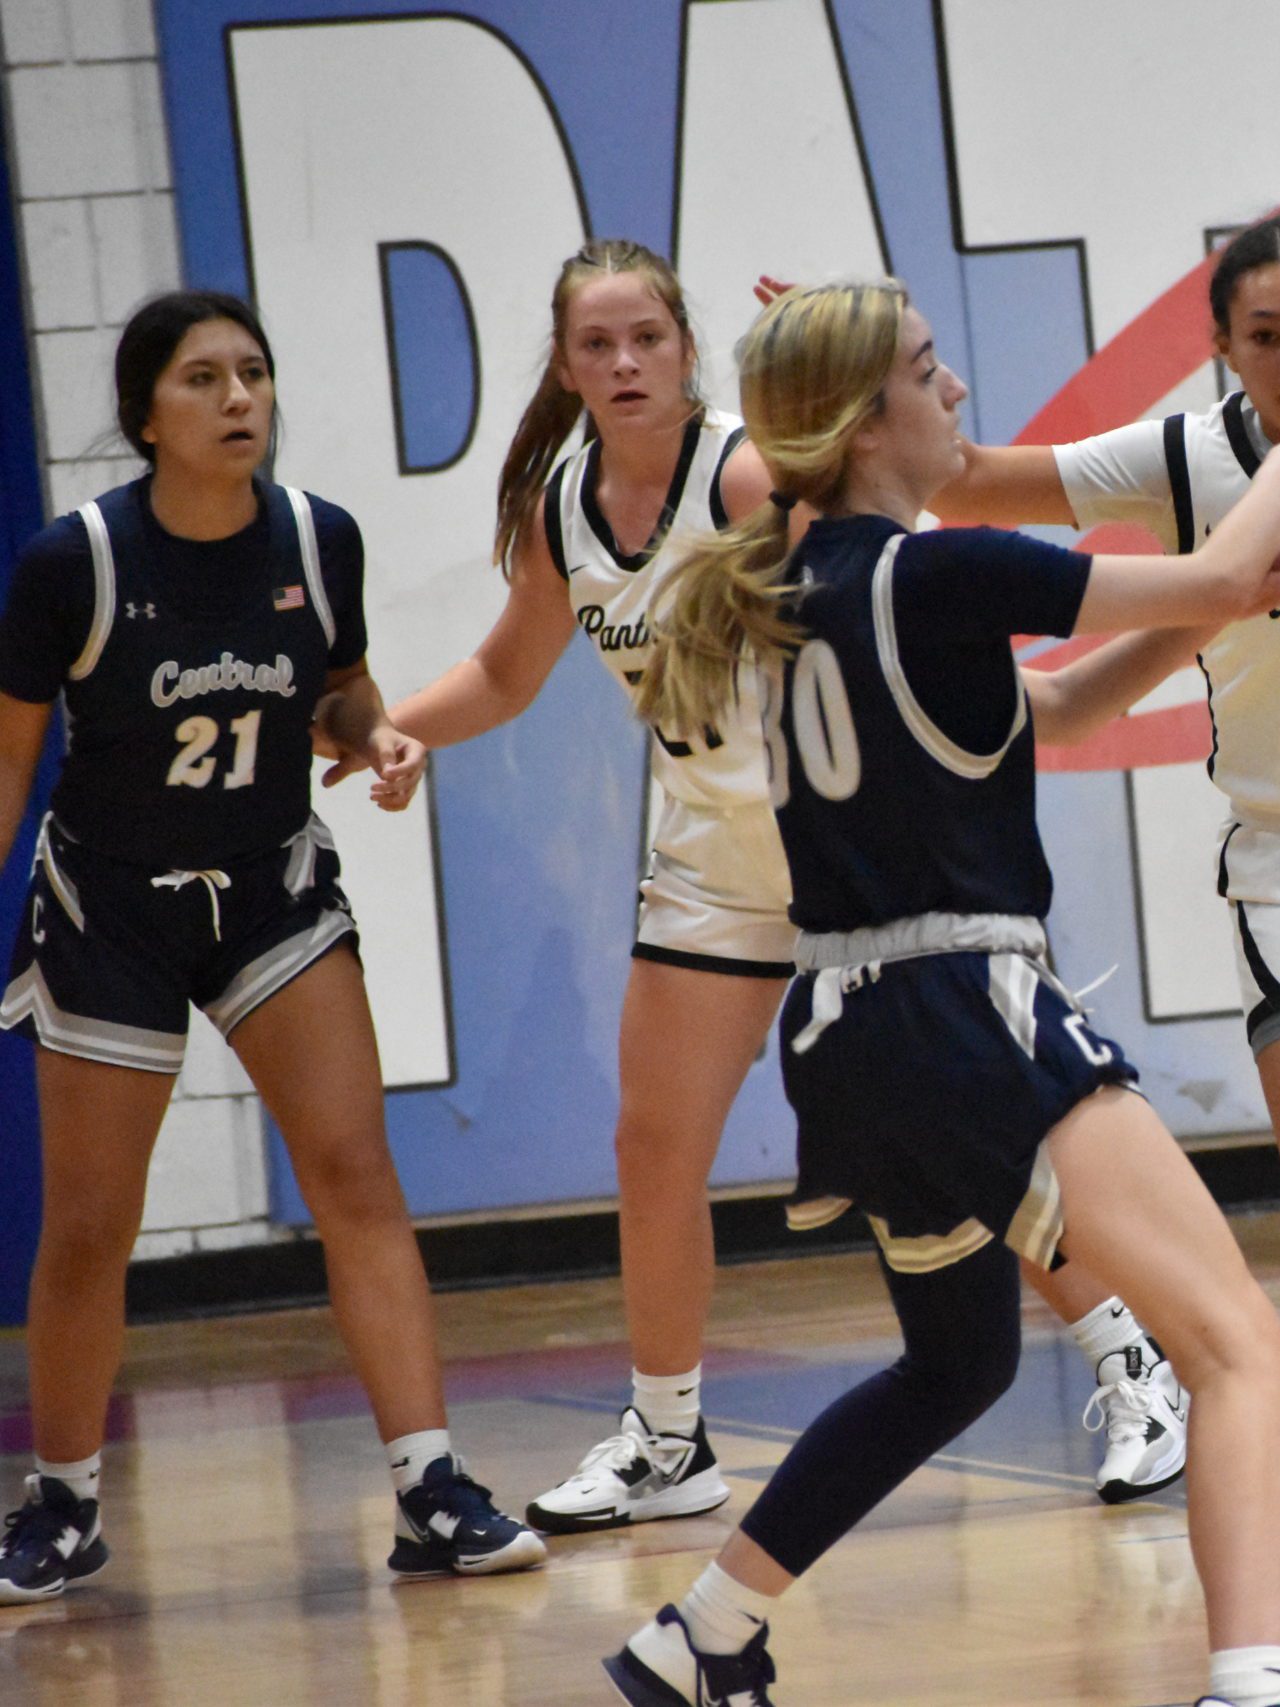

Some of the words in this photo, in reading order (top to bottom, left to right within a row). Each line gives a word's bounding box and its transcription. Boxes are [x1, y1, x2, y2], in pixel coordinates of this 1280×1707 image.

[577, 604, 650, 652] Pant
[151, 651, 297, 708] Central
[165, 709, 263, 790] 21
